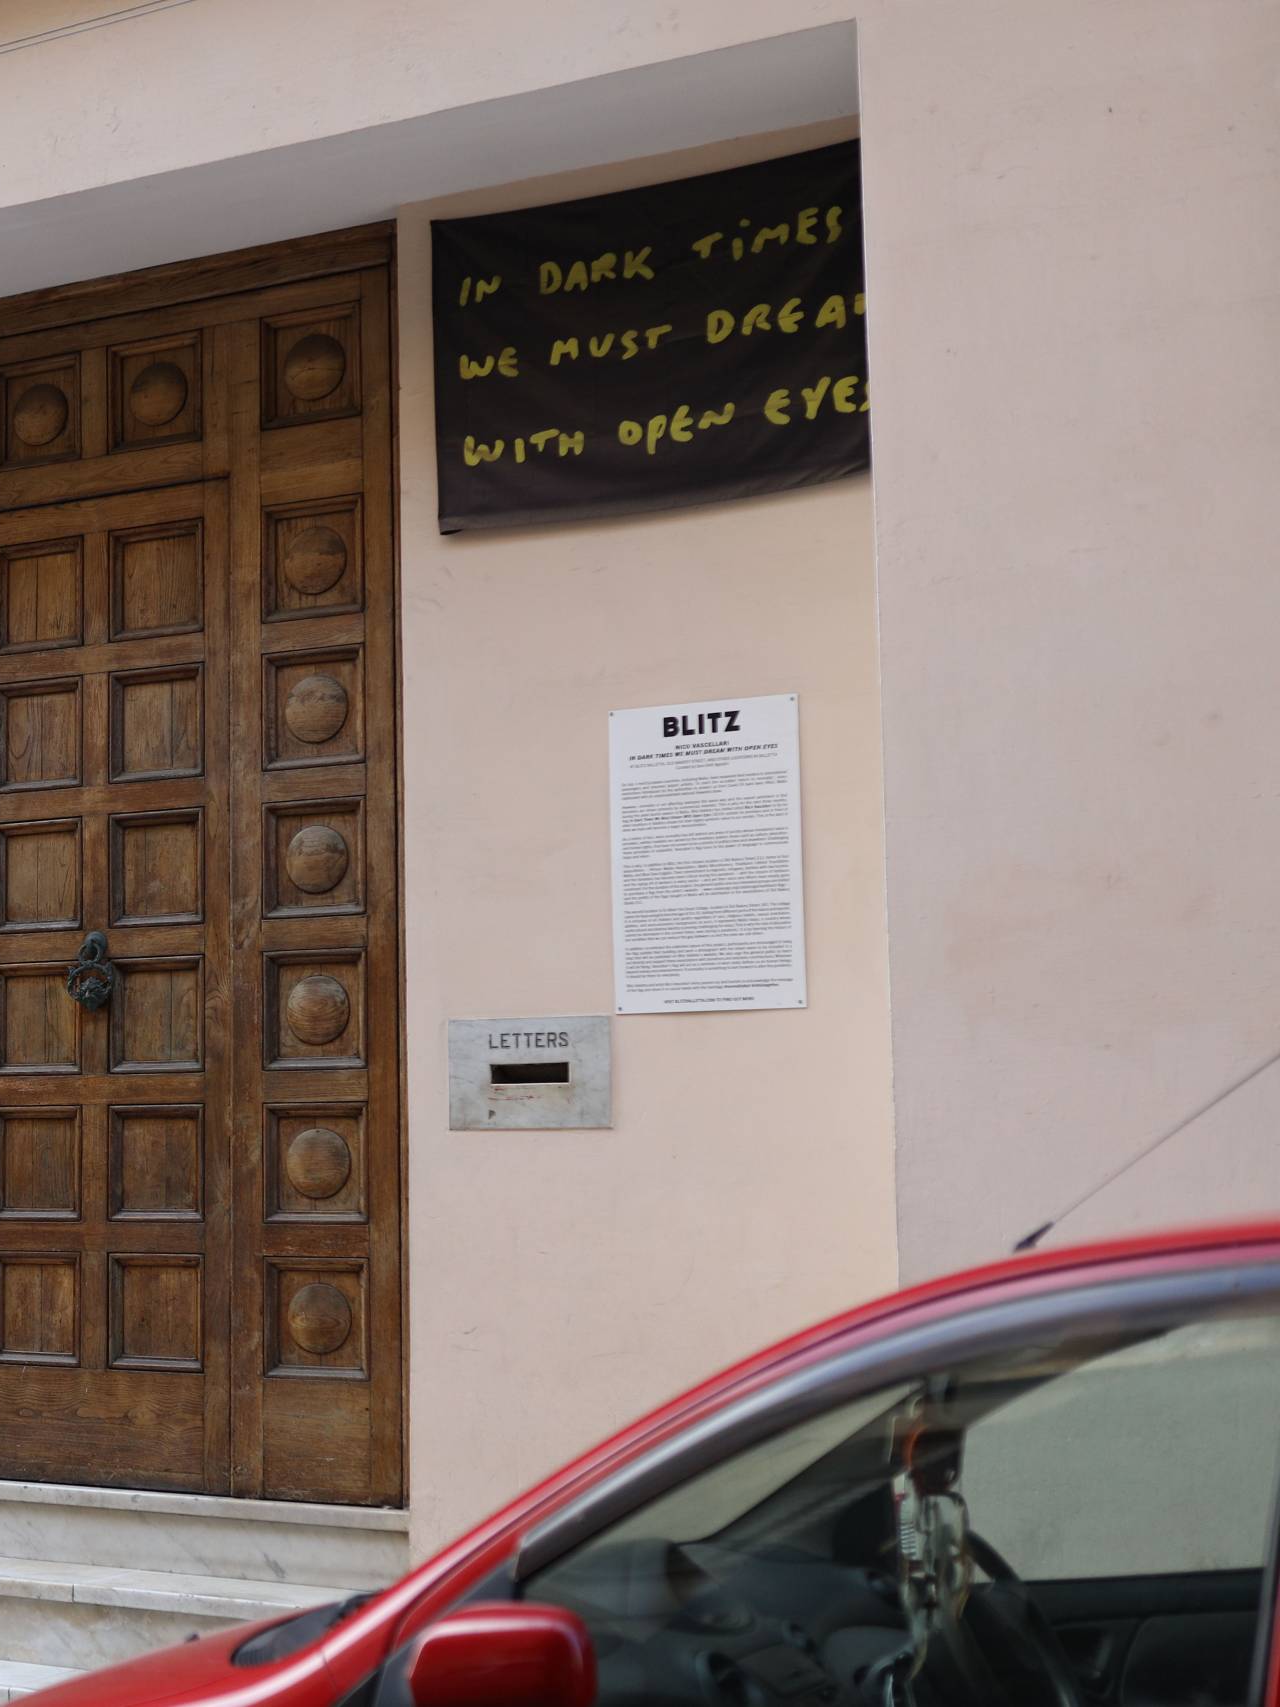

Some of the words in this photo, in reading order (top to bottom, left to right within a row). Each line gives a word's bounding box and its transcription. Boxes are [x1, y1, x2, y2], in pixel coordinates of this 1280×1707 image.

[459, 276, 501, 306] IN
[539, 246, 655, 295] DARK
[459, 347, 519, 379] WE
[549, 325, 673, 366] MUST
[463, 429, 585, 467] WITH
[618, 404, 736, 455] OPEN
[663, 710, 741, 738] BLITZ
[488, 1031, 569, 1050] LETTERS
